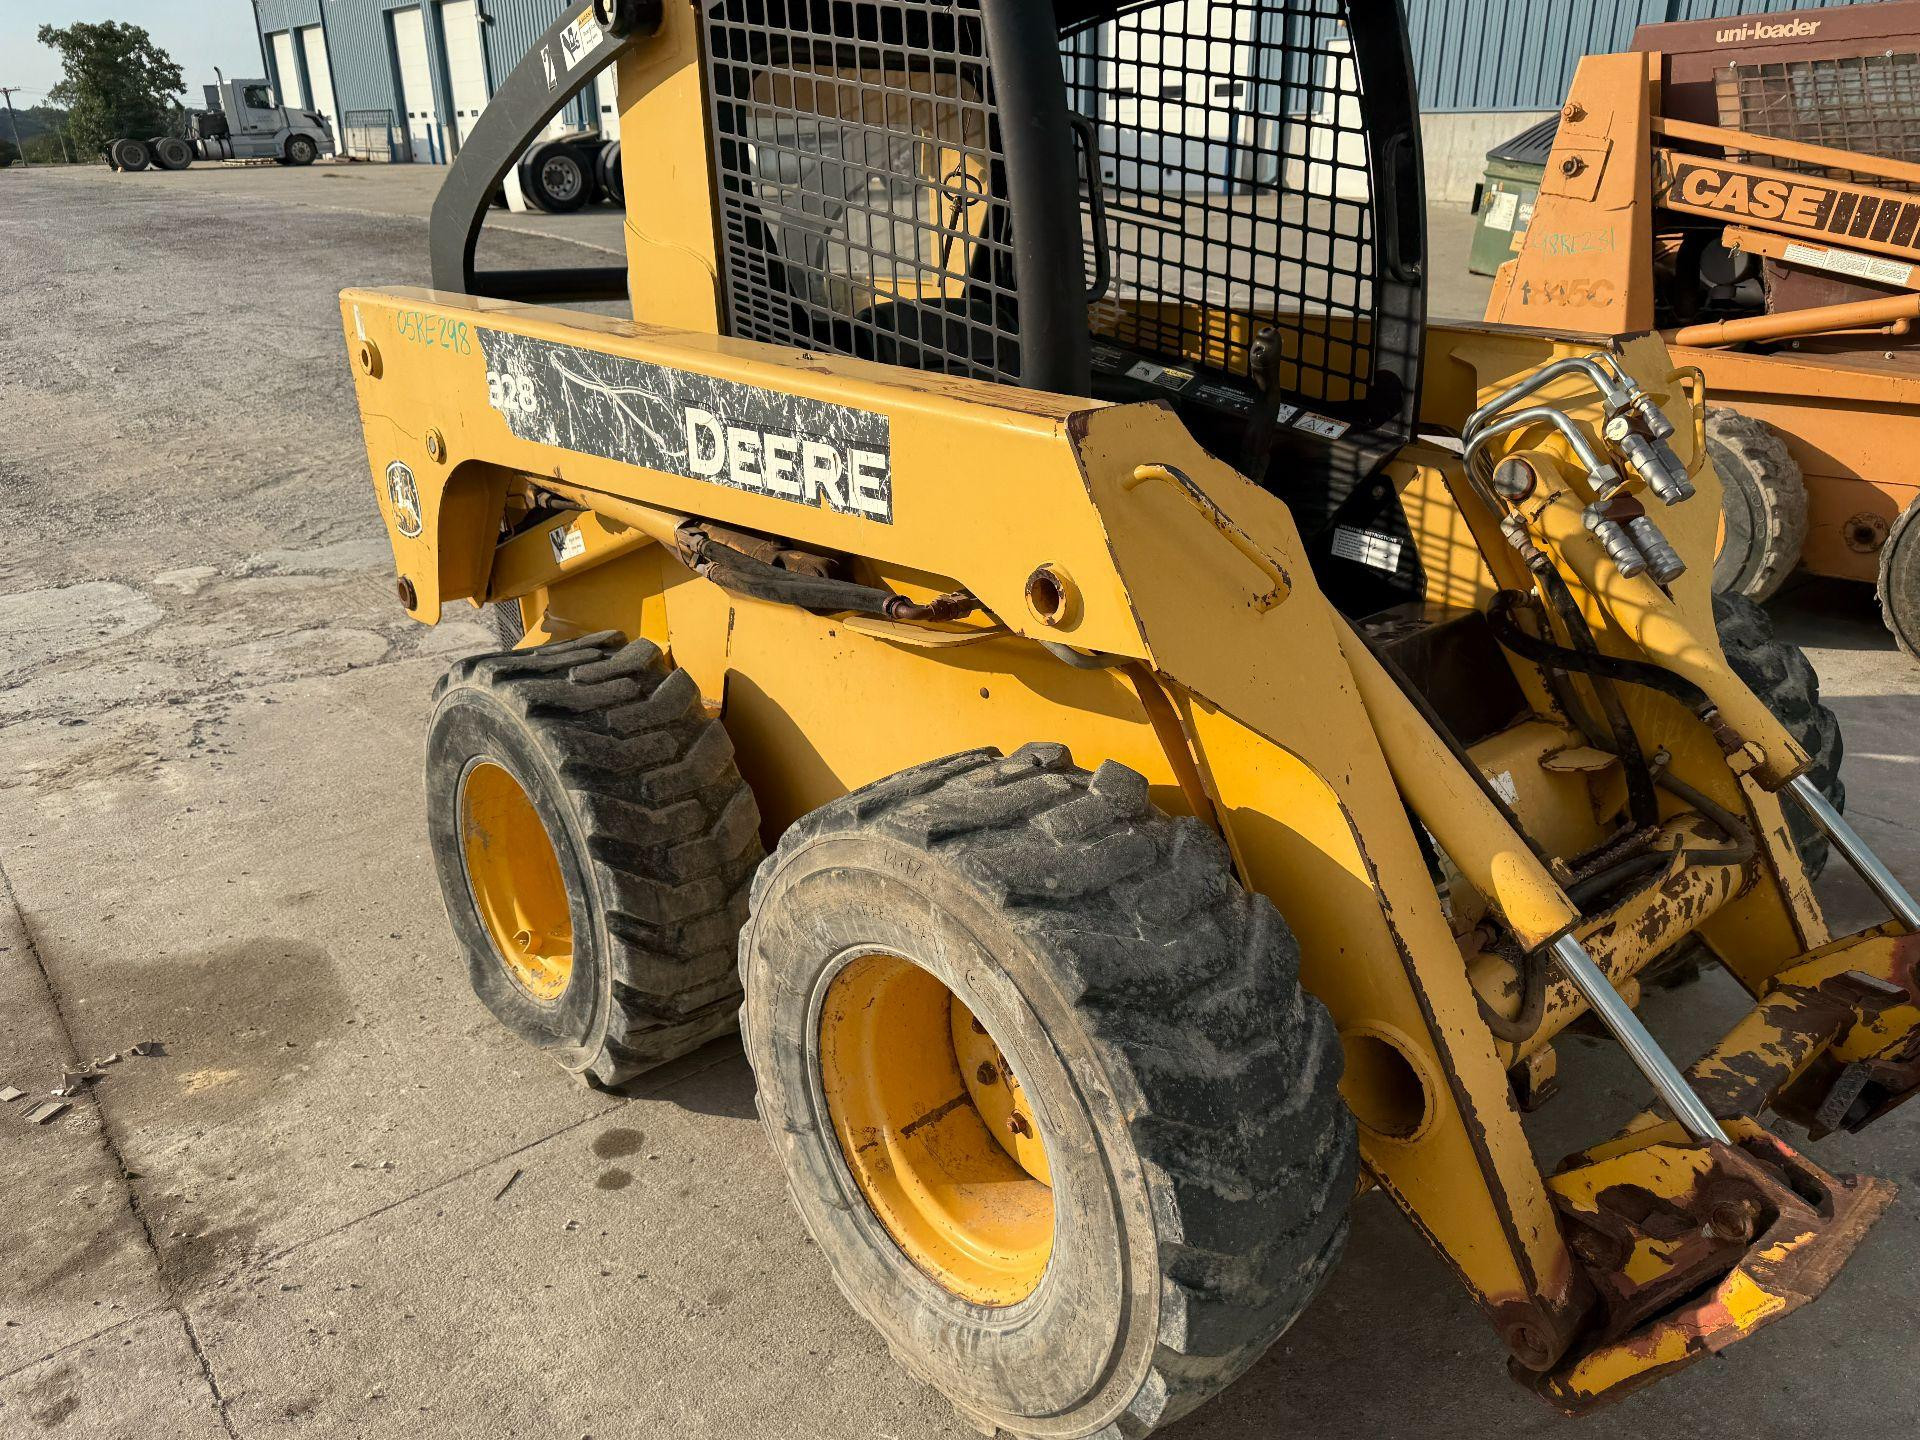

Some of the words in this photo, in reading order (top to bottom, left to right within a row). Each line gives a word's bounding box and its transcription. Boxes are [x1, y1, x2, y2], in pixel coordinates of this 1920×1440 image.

[1716, 18, 1821, 43] uni-loader
[1682, 168, 1827, 227] CASE
[396, 309, 472, 356] 05RE298
[684, 406, 889, 517] DEERE
